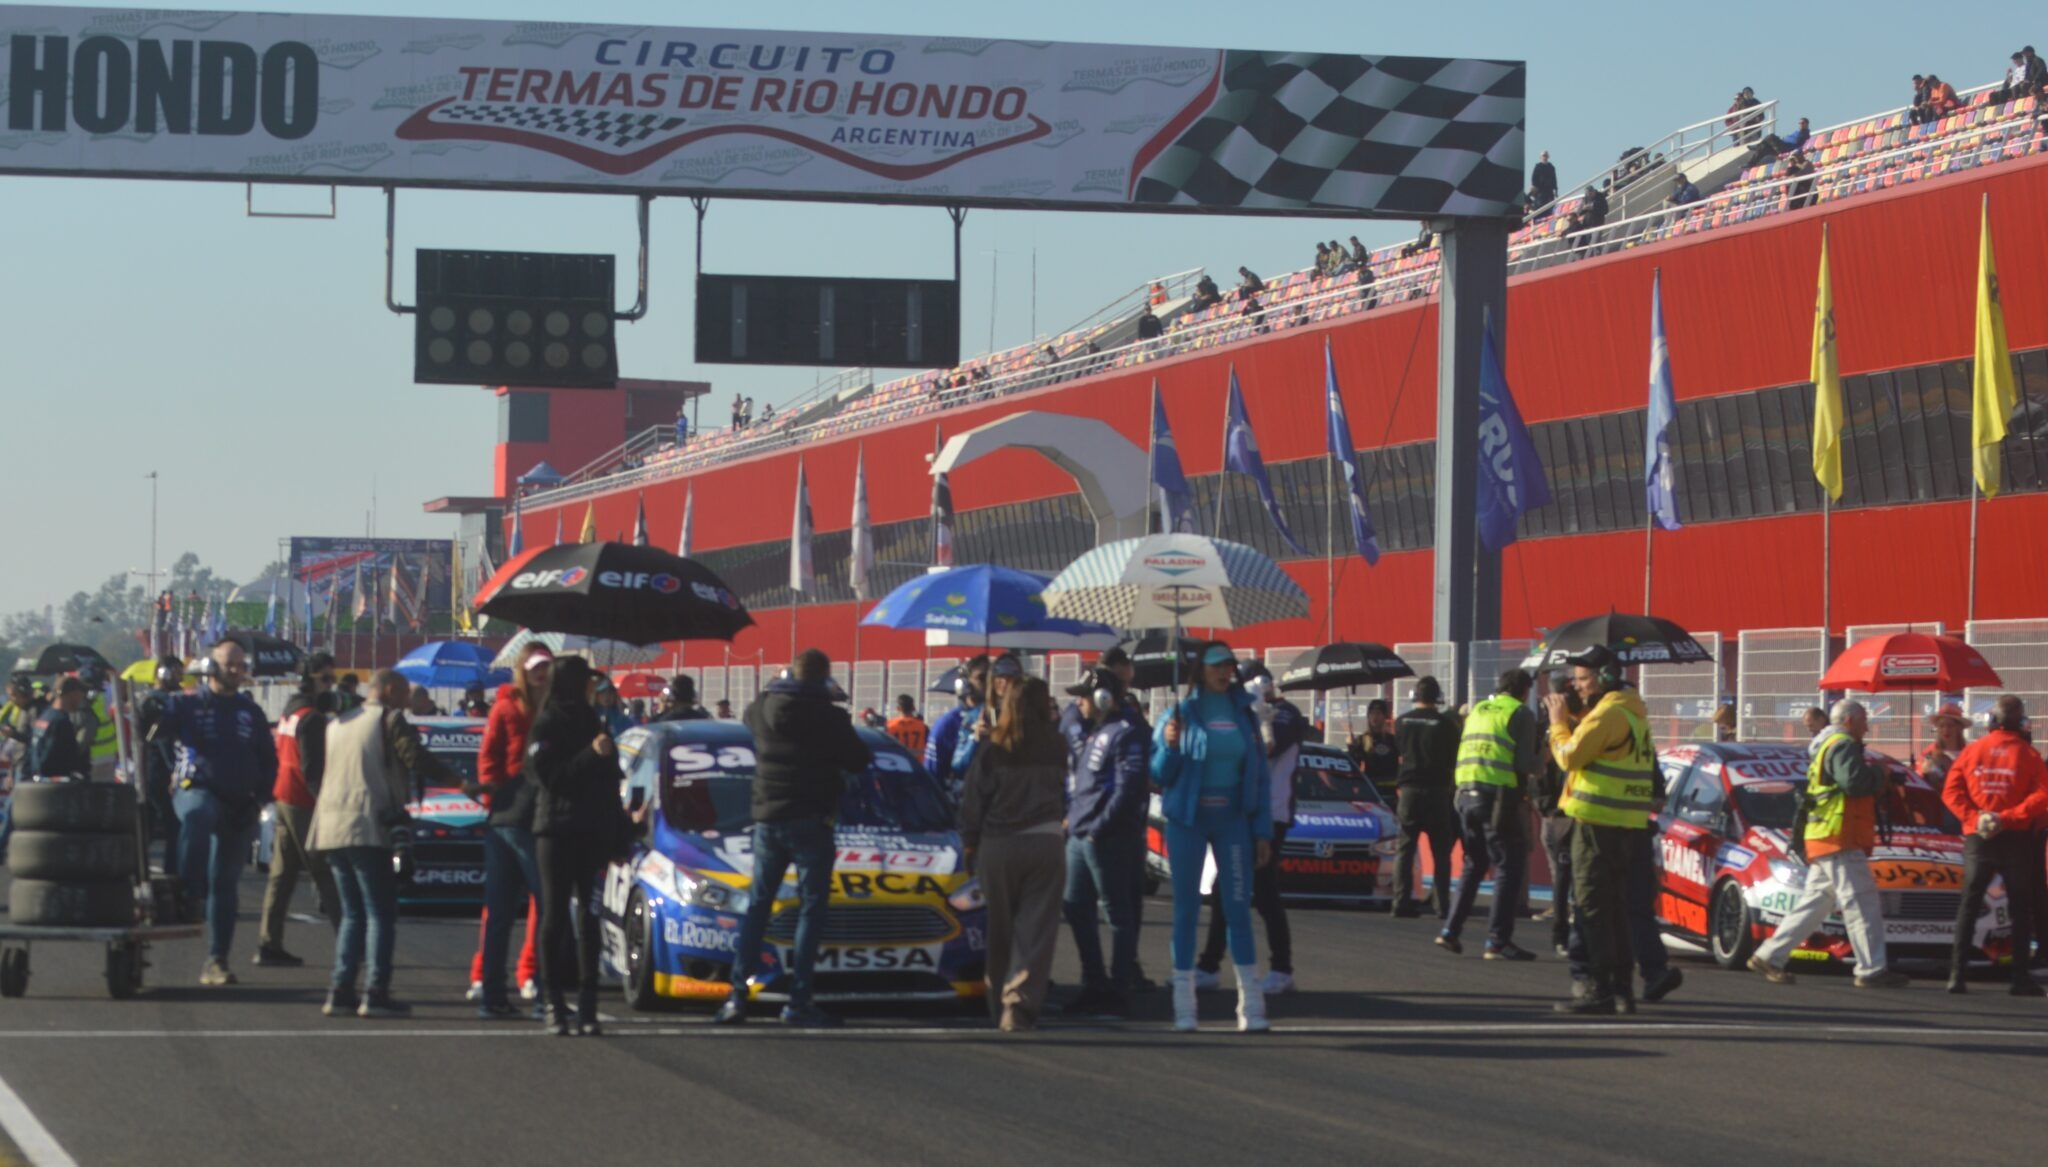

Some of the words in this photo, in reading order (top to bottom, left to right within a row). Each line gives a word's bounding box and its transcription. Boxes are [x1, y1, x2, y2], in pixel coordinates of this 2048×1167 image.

[595, 38, 896, 75] CIRCUITO
[8, 34, 319, 140] HONDO
[457, 66, 670, 108] TERMAS
[677, 73, 744, 111] DE
[846, 80, 1028, 121] HONDO
[830, 126, 977, 149] ARGENTINA
[1143, 557, 1206, 567] PALADINI
[511, 569, 564, 589] elf
[598, 571, 650, 589] elf
